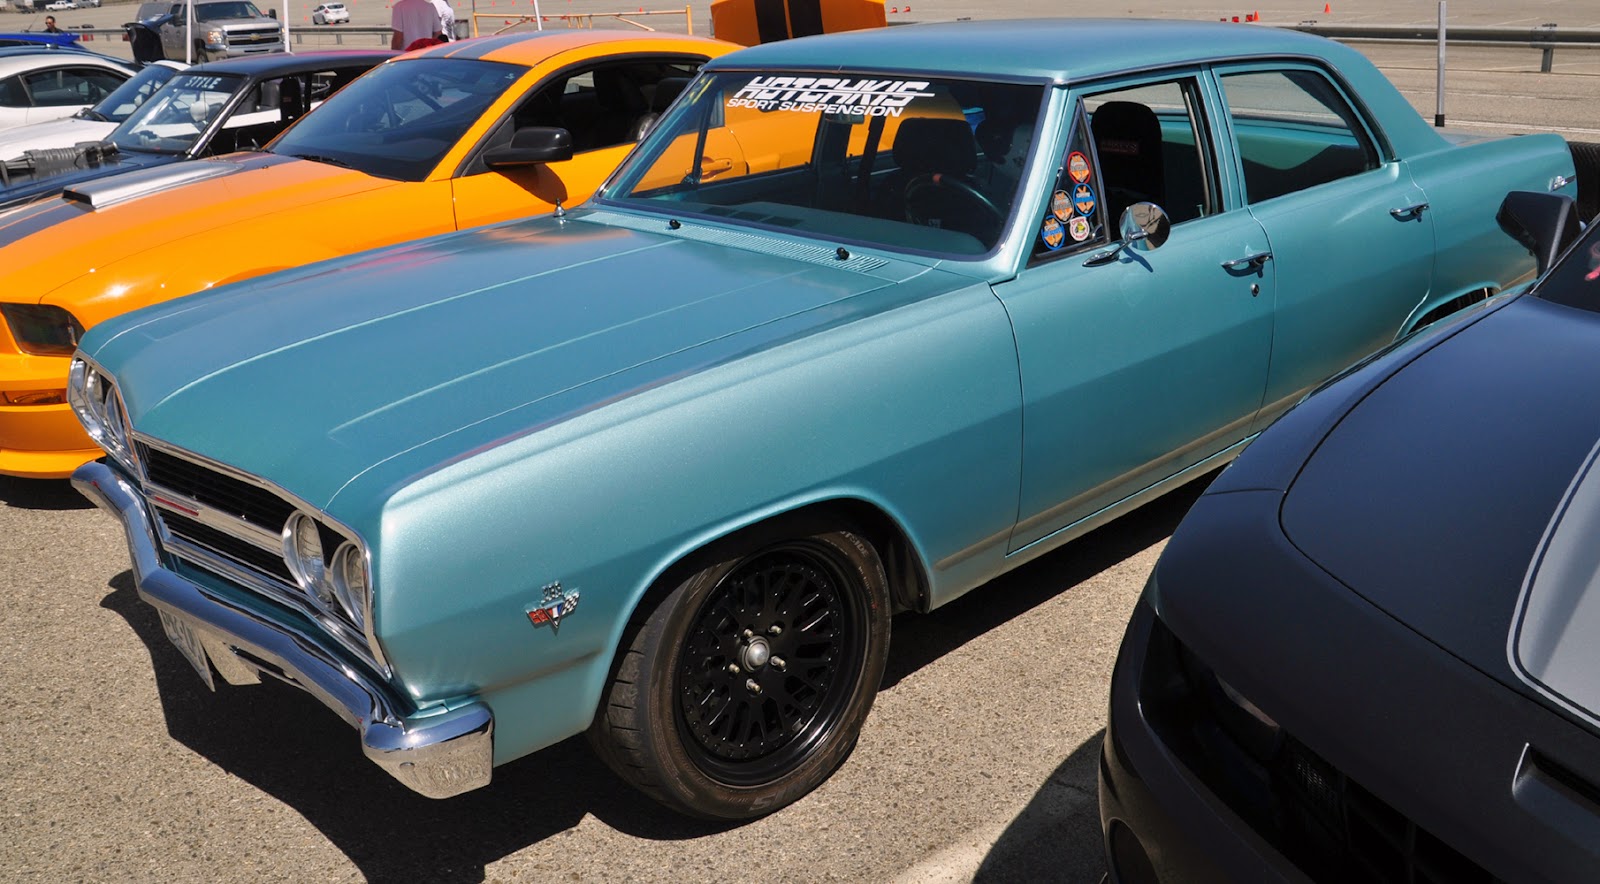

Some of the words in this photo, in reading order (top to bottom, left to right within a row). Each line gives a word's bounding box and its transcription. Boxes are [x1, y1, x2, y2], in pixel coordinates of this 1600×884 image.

[184, 75, 222, 89] STYLE
[733, 75, 935, 107] HOTCHKIS
[726, 98, 779, 111] SPORT
[780, 102, 904, 118] SUSPENSION
